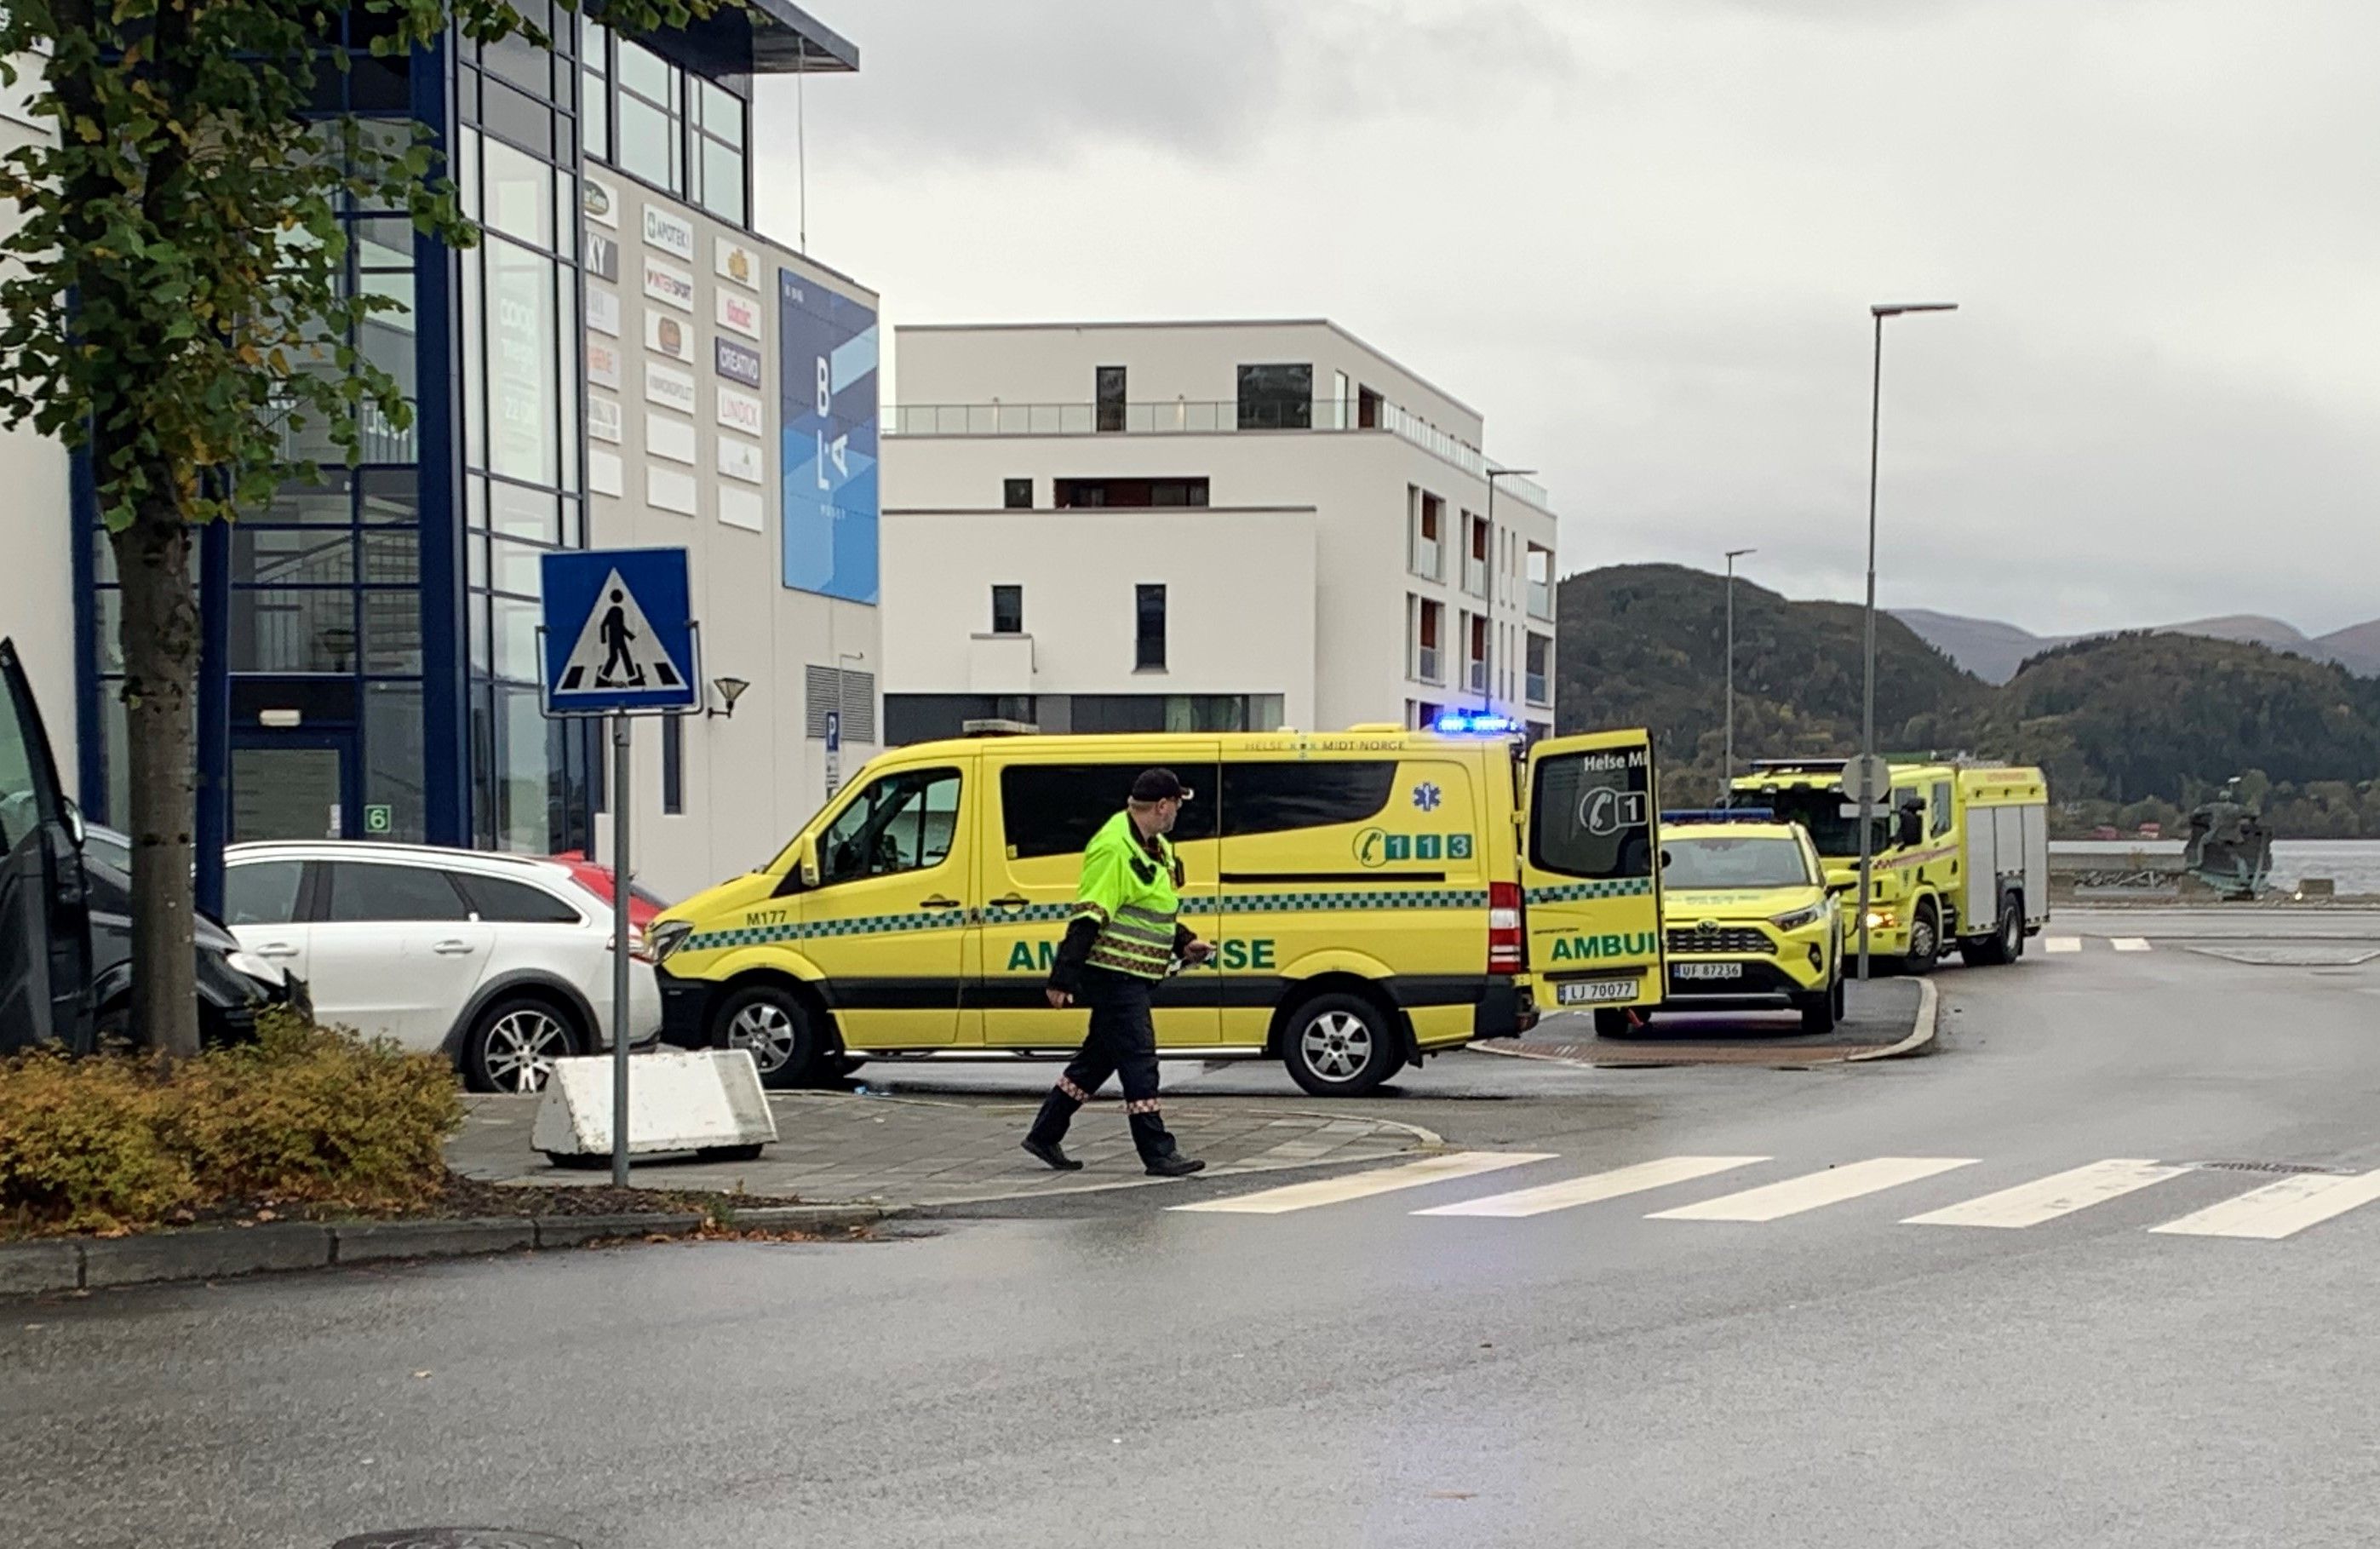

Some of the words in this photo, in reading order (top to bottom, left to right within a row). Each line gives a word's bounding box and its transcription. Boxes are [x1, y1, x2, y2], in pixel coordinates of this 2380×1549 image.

[829, 715, 836, 747] P
[1322, 741, 1354, 751] MIDT
[1360, 741, 1405, 751] NORGE
[1585, 754, 1626, 772] Helse
[370, 809, 386, 829] 6
[746, 909, 787, 926] M177
[1682, 964, 1699, 977] UF
[1703, 963, 1739, 977] 87236
[1591, 983, 1632, 998] 70077
